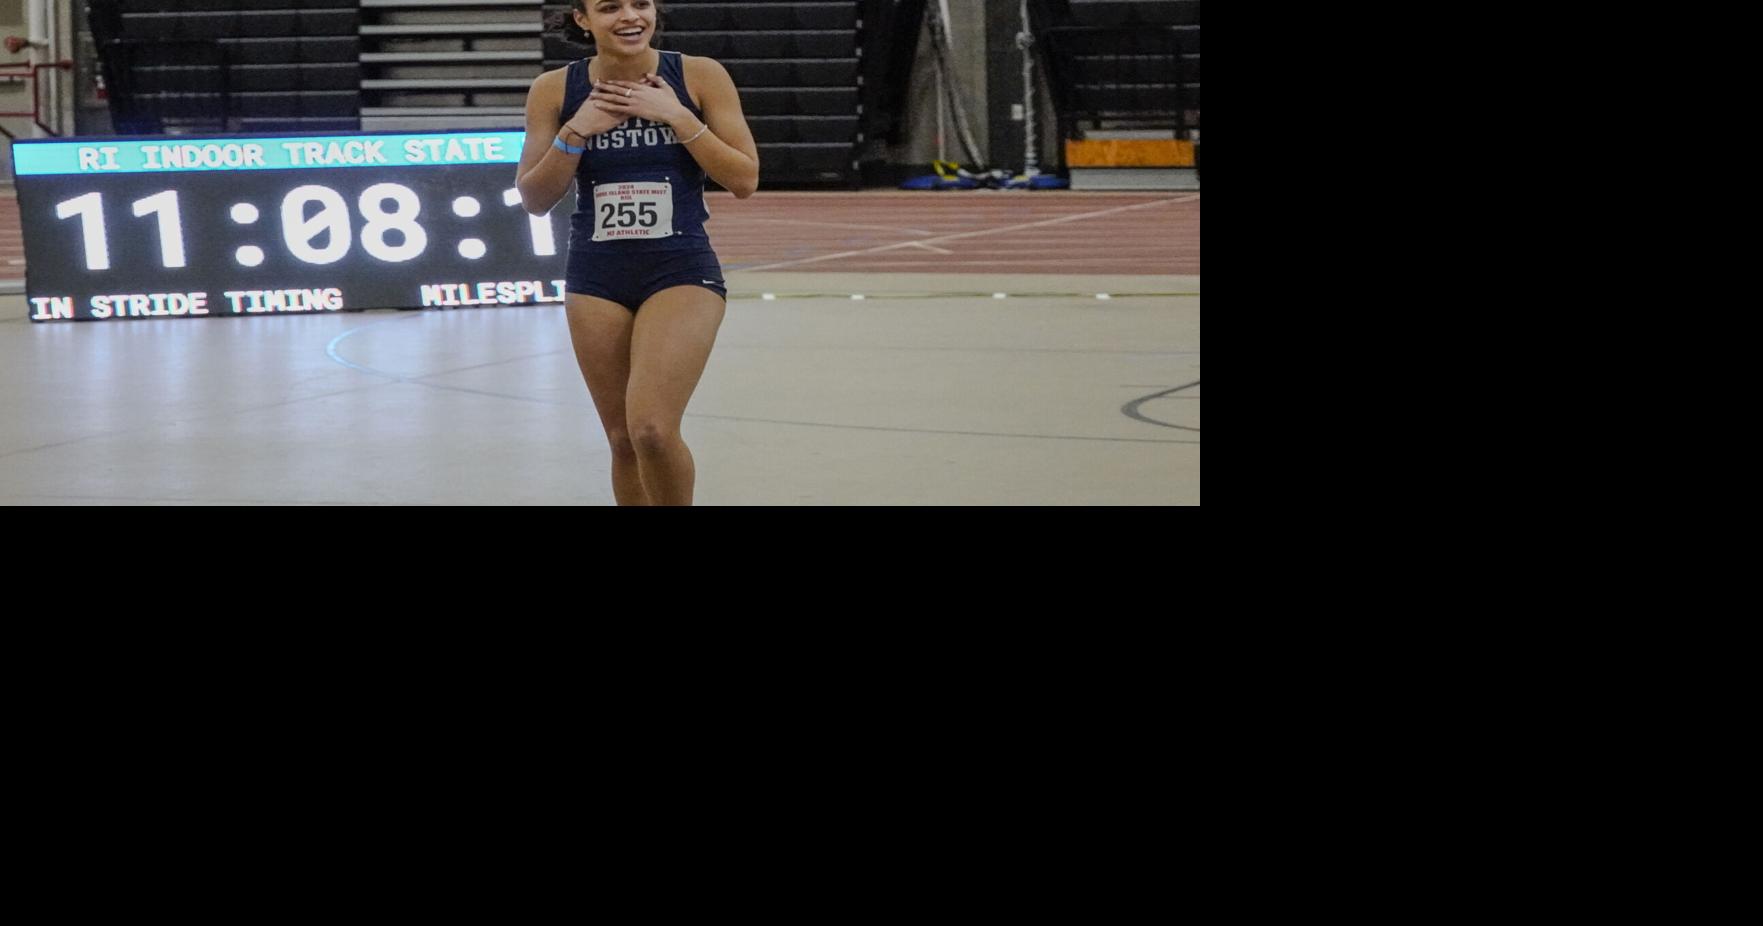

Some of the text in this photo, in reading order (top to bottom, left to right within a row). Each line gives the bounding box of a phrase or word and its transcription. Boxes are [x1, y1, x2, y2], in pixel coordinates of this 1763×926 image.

[79, 137, 505, 170] RI INDOOR TRACK STATE
[600, 202, 658, 229] 255
[616, 228, 650, 236] ATHLETIC
[30, 288, 344, 321] IN STRIDE TIMING
